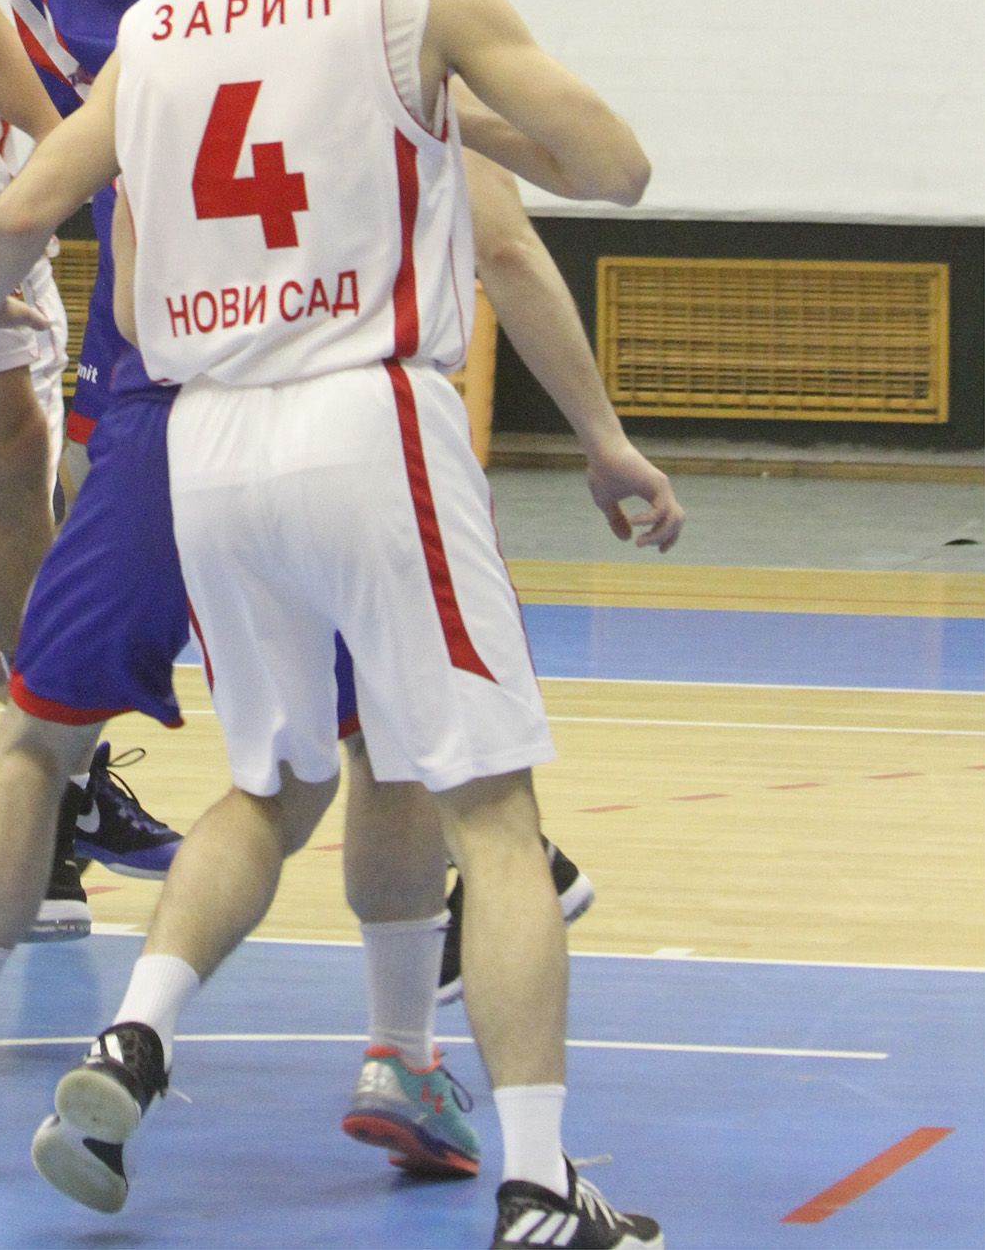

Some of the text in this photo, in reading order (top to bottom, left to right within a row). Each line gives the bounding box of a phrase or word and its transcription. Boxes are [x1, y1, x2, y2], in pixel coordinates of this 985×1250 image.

[191, 80, 310, 250] 4
[166, 269, 360, 338] НОВИ САД
